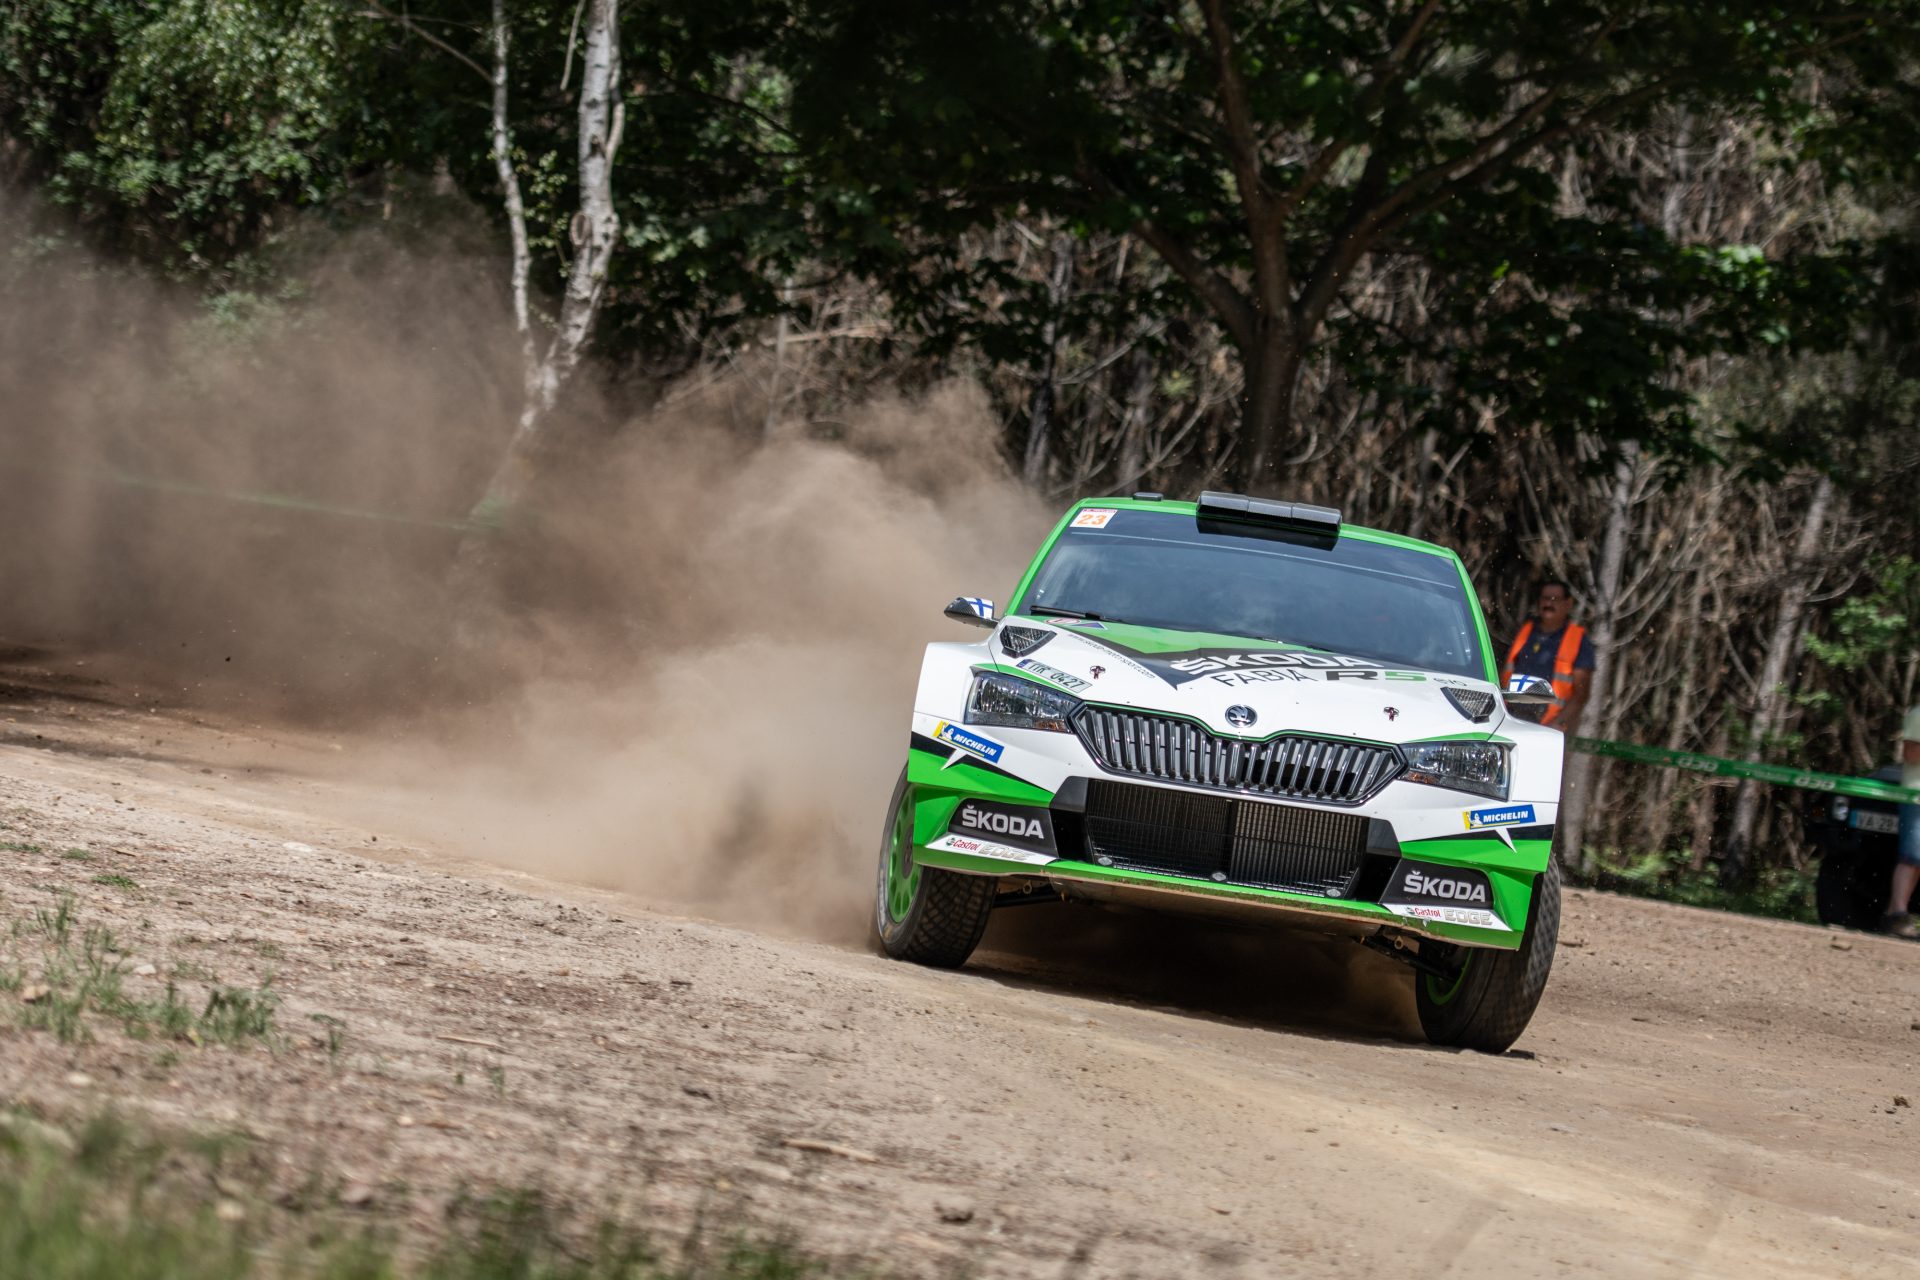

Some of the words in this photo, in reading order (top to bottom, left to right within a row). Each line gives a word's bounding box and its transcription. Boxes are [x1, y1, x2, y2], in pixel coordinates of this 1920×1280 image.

[1076, 514, 1107, 525] 23
[1170, 652, 1385, 677] ŠKODA
[1211, 668, 1319, 687] FABIA
[1325, 670, 1428, 682] R5
[953, 733, 997, 757] MICHELIN
[961, 805, 1045, 839] ŠKODA
[1482, 810, 1529, 823] MICHELIN
[953, 838, 982, 852] Castrol
[1403, 870, 1486, 903] ŠKODA
[1414, 907, 1442, 918] Castrol
[1443, 908, 1494, 926] EDGE
